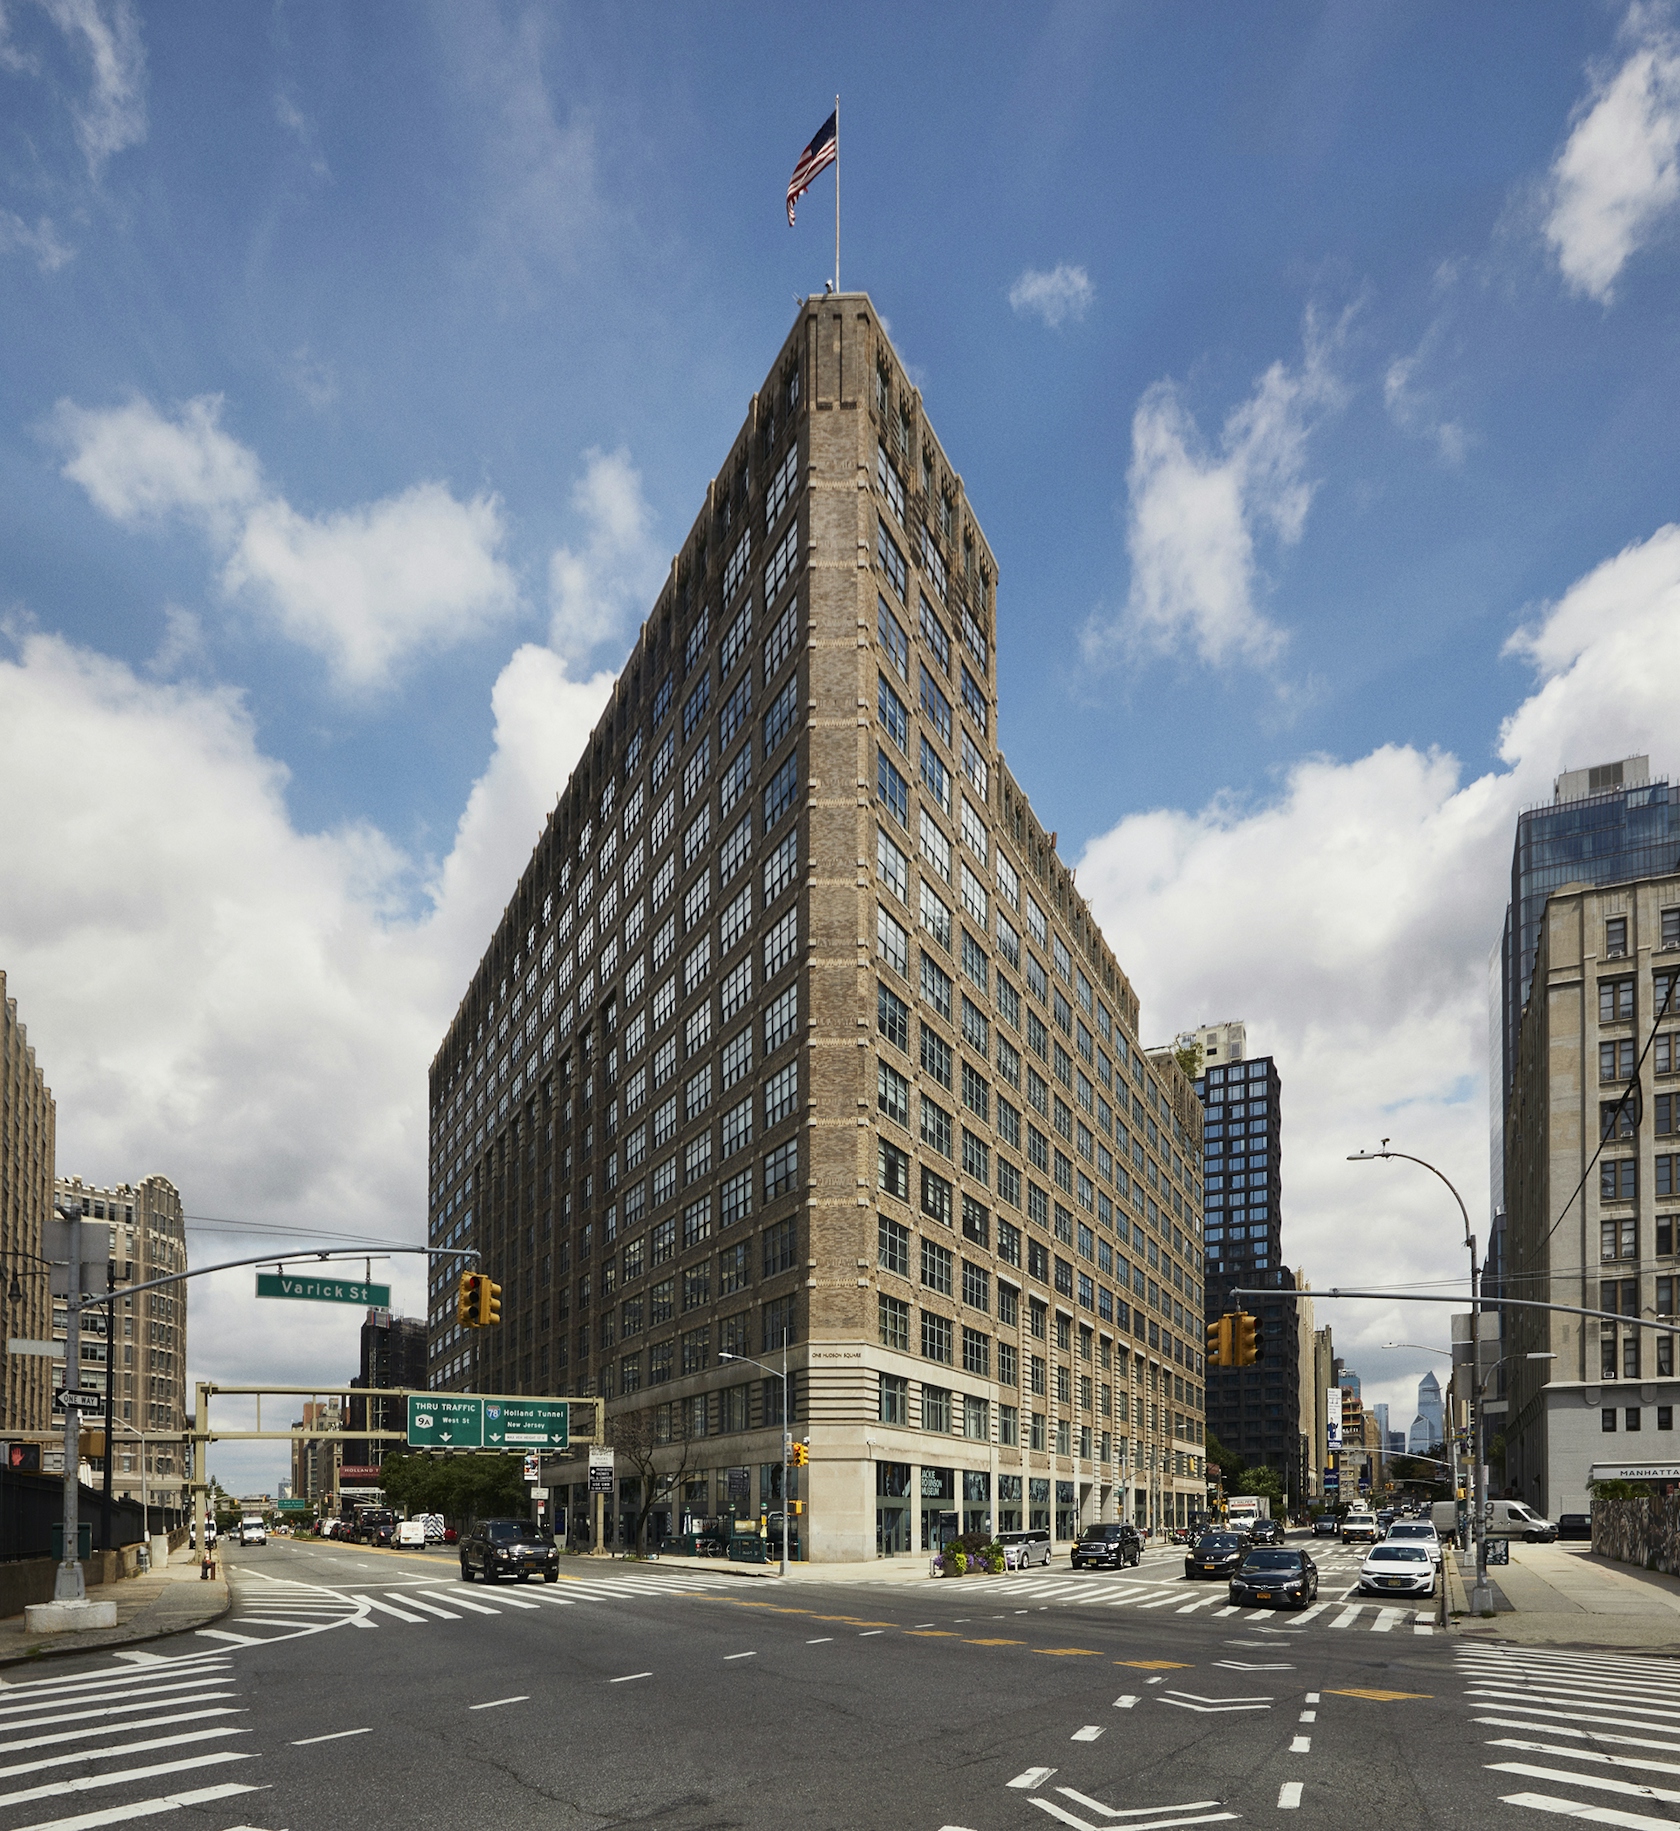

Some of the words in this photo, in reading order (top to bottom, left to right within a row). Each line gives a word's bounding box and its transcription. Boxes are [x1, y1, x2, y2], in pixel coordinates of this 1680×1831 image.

[281, 1280, 343, 1298] Varick
[349, 1286, 368, 1301] St
[64, 1394, 78, 1404] ONE
[81, 1397, 95, 1405] WAY
[415, 1402, 439, 1411] THRU
[441, 1403, 476, 1412] TRAFFIC
[488, 1410, 499, 1418] 78
[504, 1409, 534, 1417] Holland
[538, 1410, 564, 1418] Tunnel
[418, 1413, 431, 1426] 9A
[523, 1422, 545, 1430] Jersey
